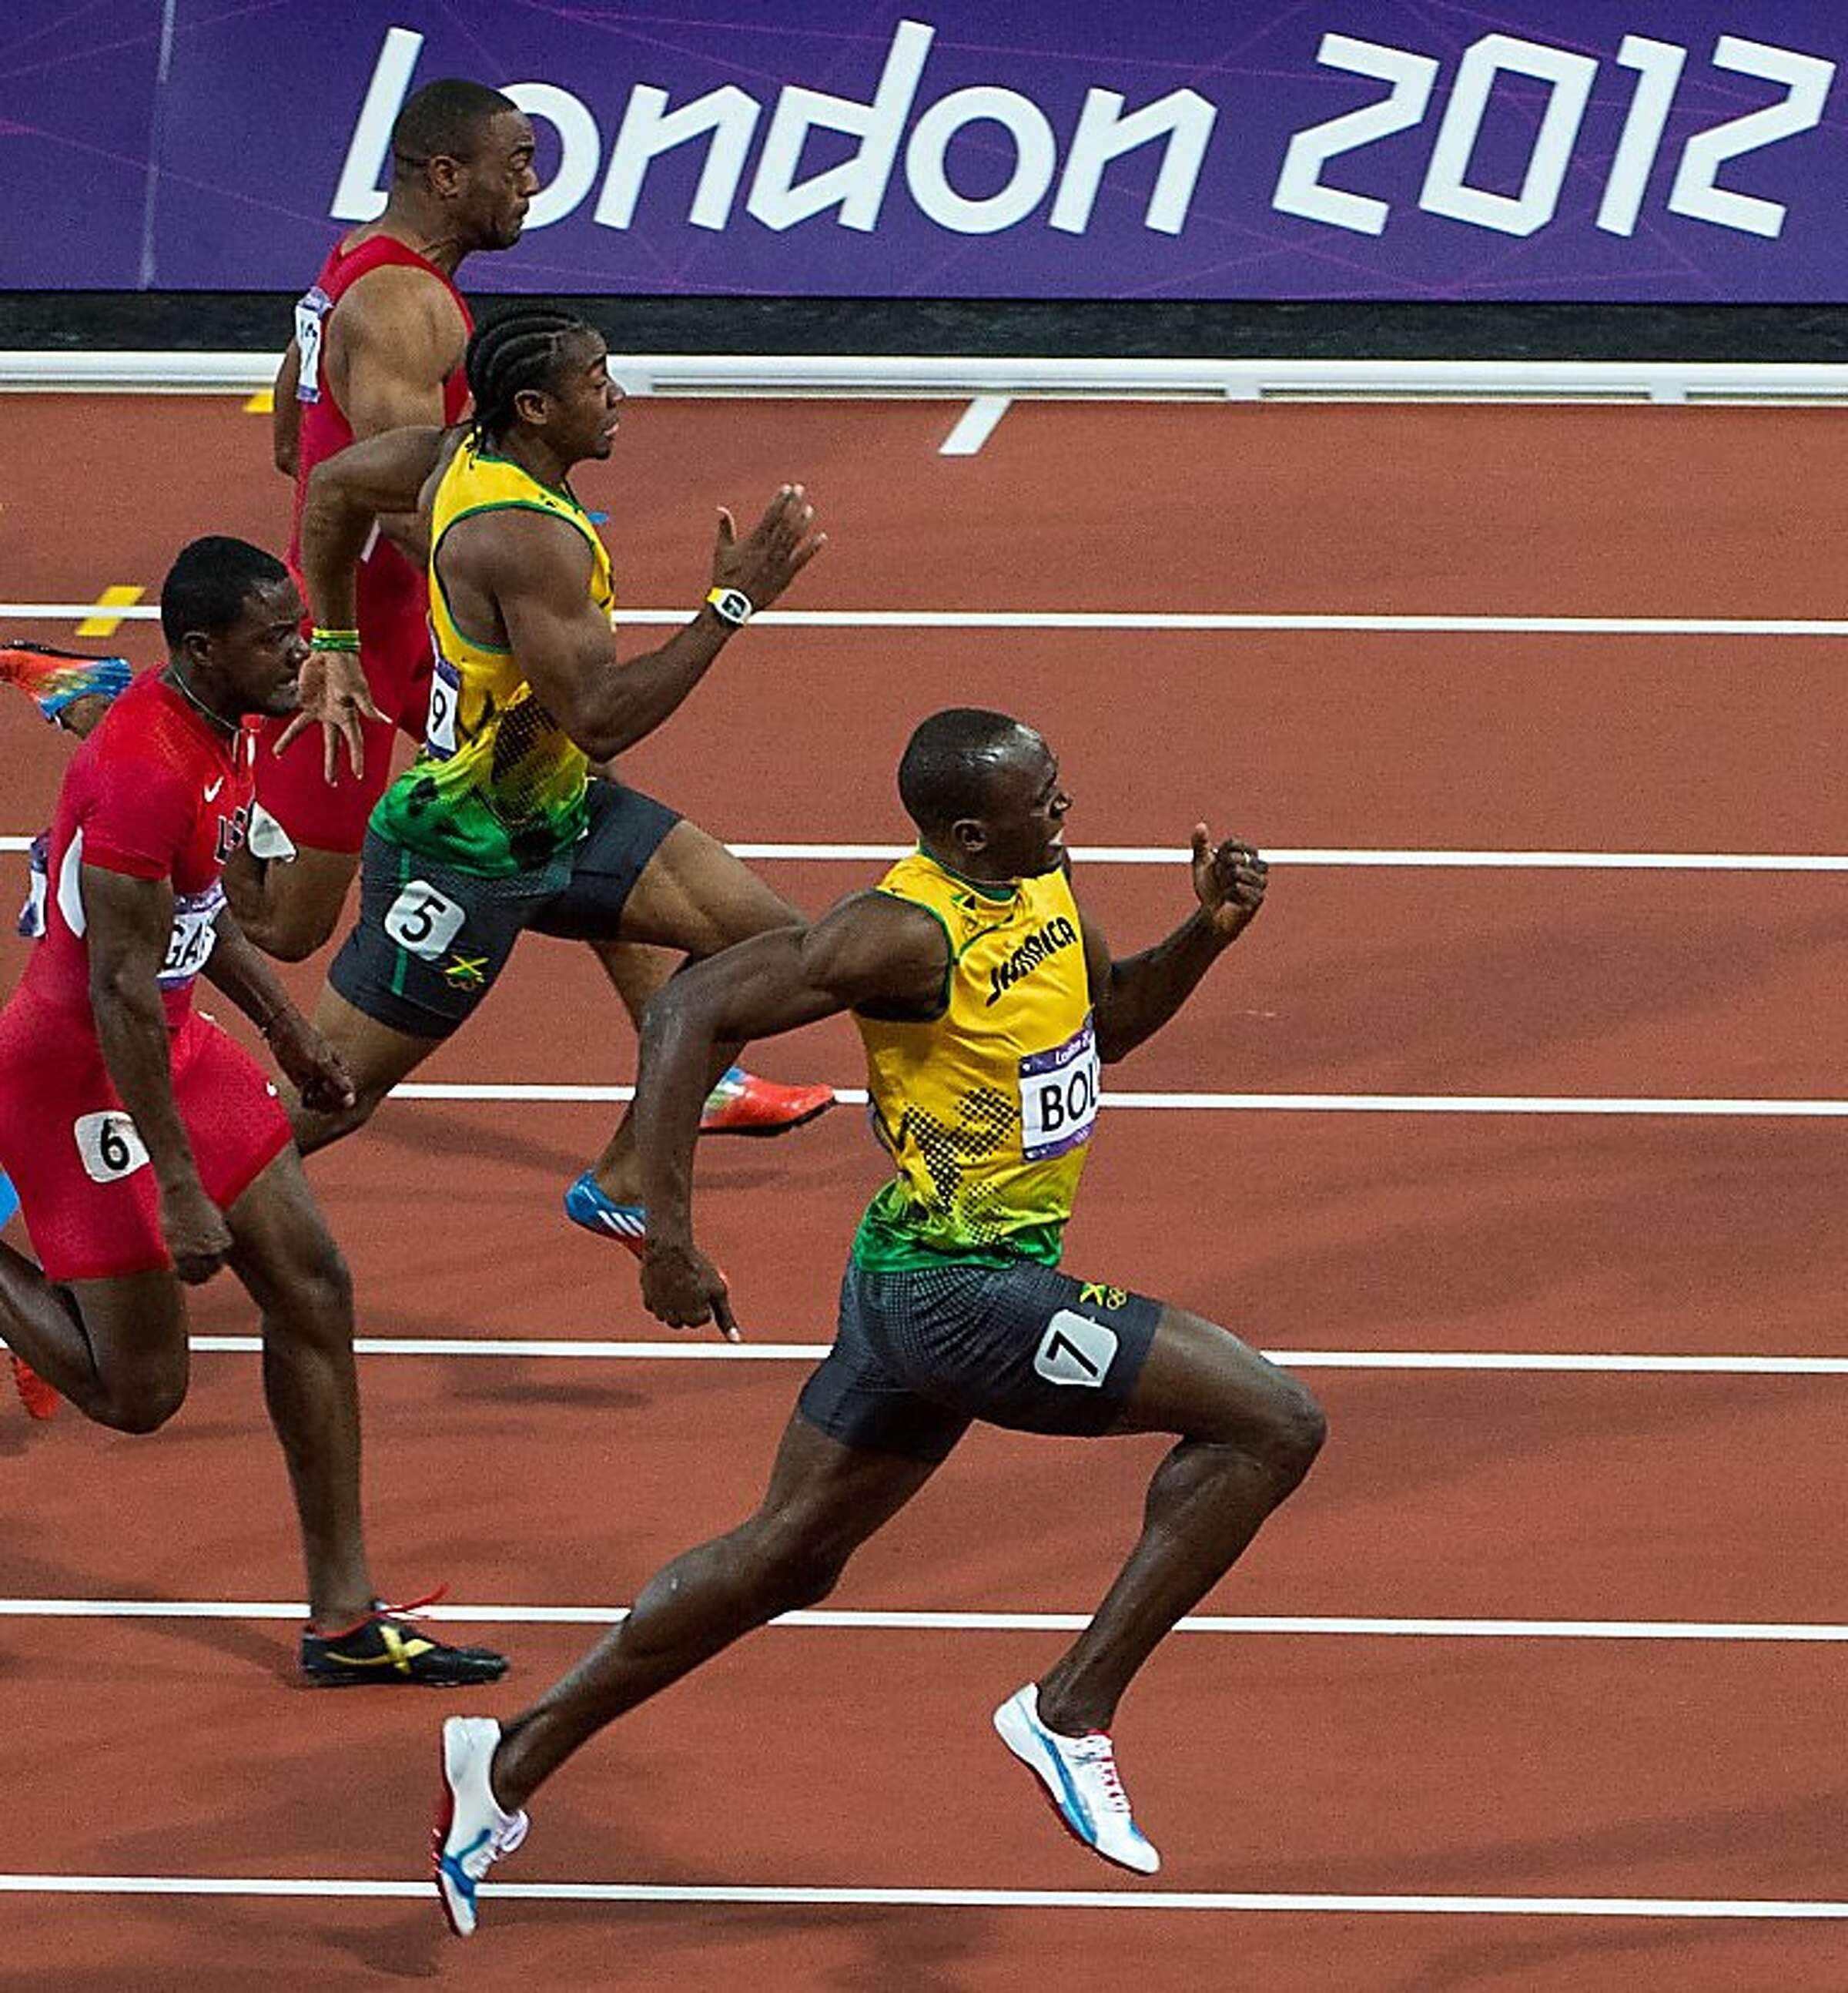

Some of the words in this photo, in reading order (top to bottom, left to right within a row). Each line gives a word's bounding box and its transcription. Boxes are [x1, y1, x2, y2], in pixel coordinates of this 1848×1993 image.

[330, 19, 1217, 235] London
[1272, 32, 1837, 239] 2012
[400, 895, 447, 943] 5
[985, 916, 1079, 1007] JAMAICA
[1040, 1062, 1096, 1133] BOL
[100, 1118, 130, 1171] 6
[1045, 1329, 1099, 1378] 7
